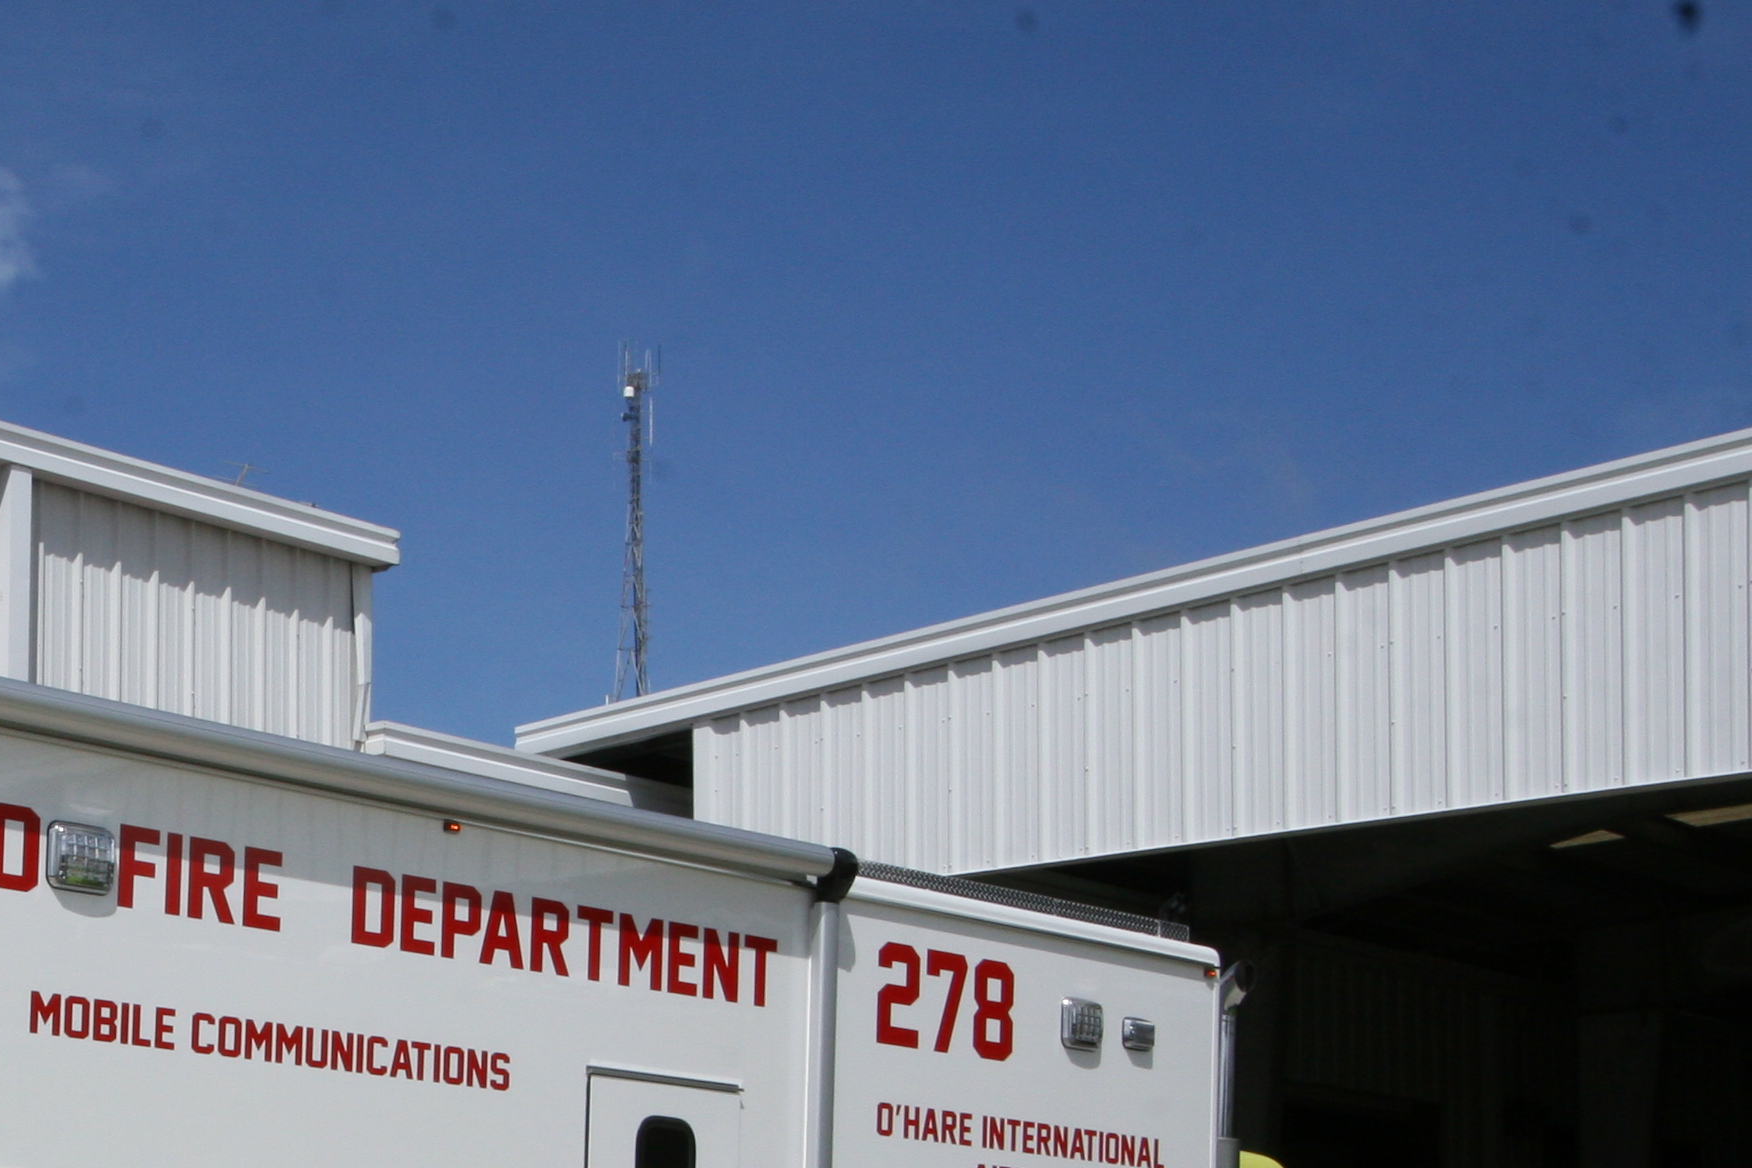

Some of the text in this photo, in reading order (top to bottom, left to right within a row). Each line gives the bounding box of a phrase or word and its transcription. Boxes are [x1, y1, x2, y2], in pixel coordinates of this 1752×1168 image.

[117, 824, 283, 933] FIRE
[351, 866, 778, 1008] DEPARTMENT
[29, 990, 511, 1092] MOBILE COMMUNICATIONS
[876, 941, 1015, 1062] 278
[875, 1102, 973, 1147] O'HARE
